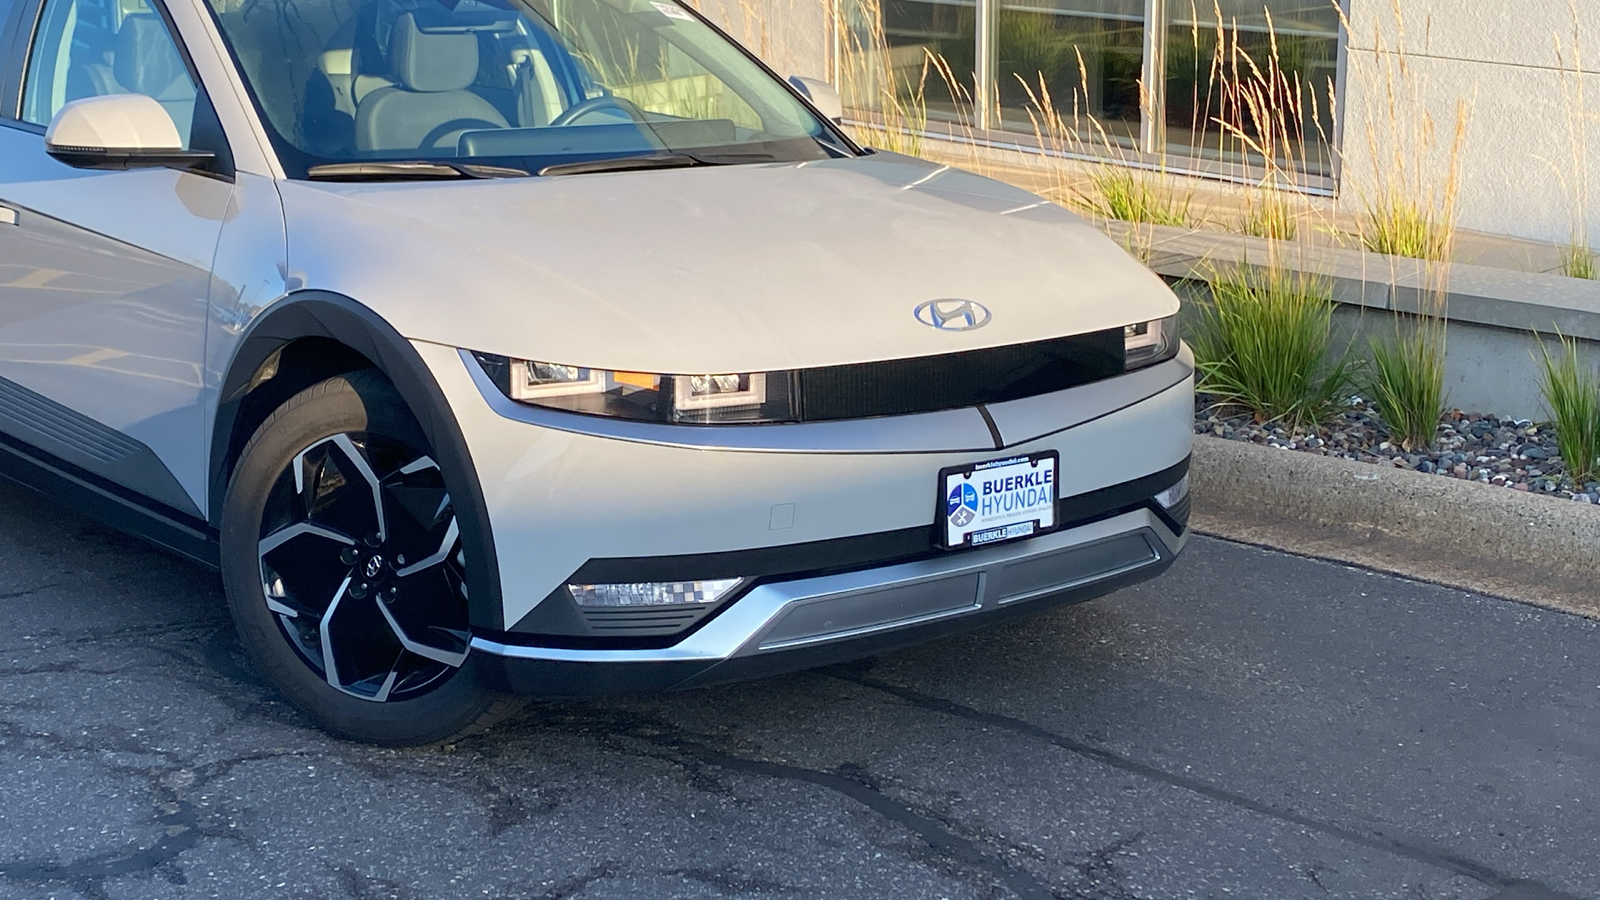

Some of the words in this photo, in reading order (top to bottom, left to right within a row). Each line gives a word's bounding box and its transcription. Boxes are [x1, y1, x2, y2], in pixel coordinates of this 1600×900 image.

[982, 469, 1052, 495] BUERKLE
[982, 485, 1052, 516] HYUNDAI
[973, 529, 1007, 543] BUERKLE
